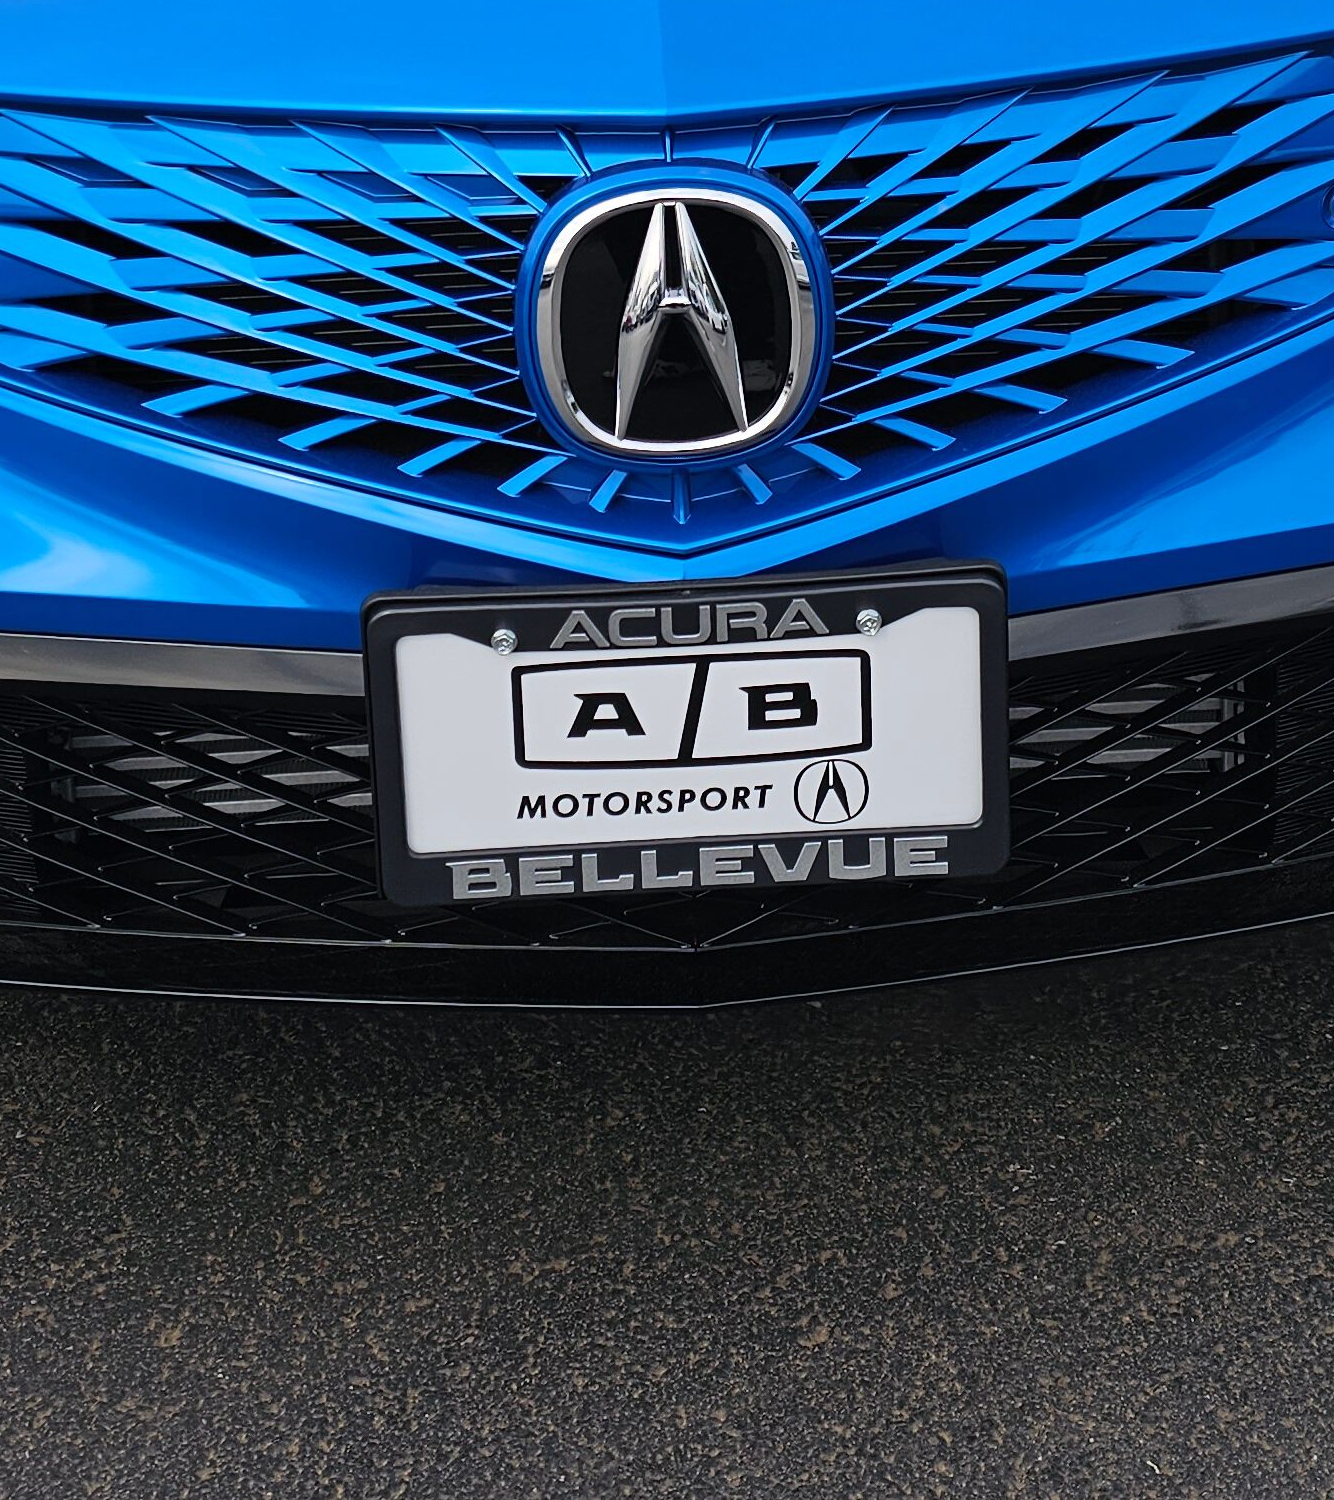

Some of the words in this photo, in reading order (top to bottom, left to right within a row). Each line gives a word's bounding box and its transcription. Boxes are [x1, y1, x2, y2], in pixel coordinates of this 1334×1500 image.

[549, 598, 830, 649] ACURA
[517, 784, 774, 820] MOTORSPORT
[445, 836, 949, 900] BELLEVUE
